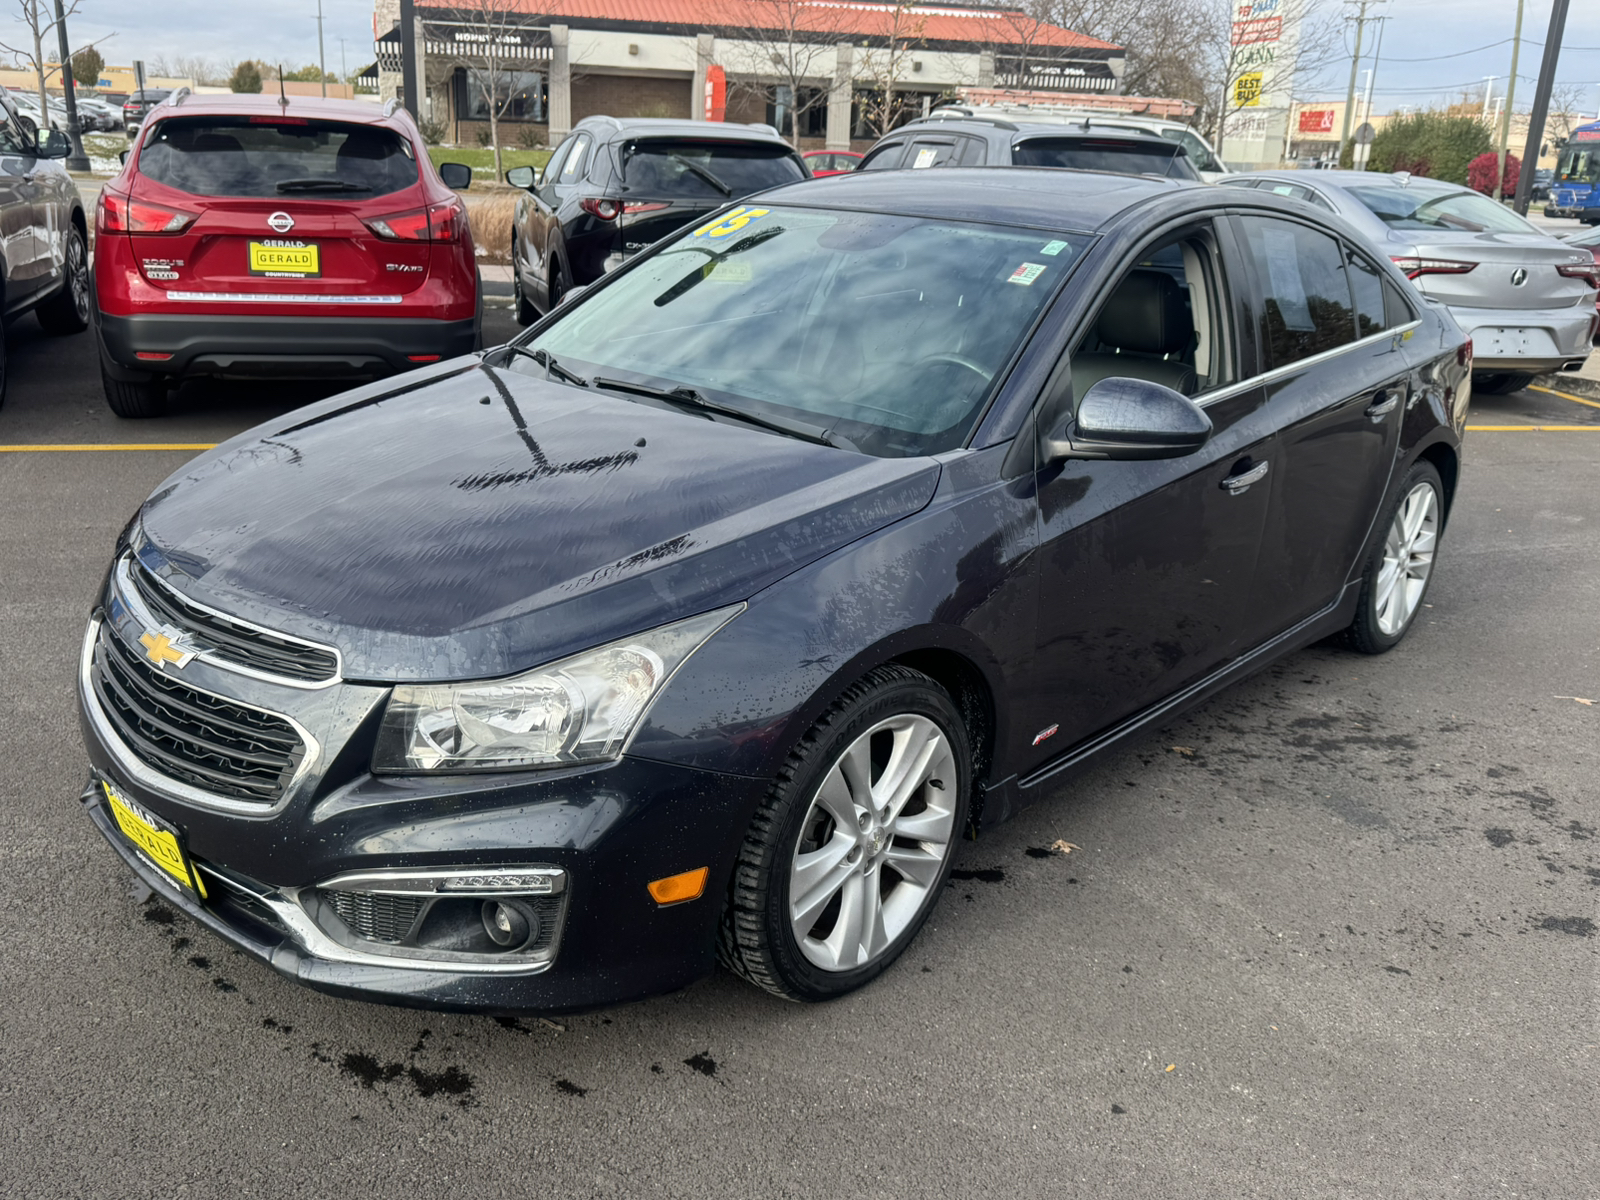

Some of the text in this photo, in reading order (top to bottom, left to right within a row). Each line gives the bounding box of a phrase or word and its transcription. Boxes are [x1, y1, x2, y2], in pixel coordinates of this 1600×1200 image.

[1238, 78, 1261, 89] BEST
[1238, 90, 1256, 101] BUY
[693, 207, 770, 237] 15
[263, 239, 305, 249] GERALD
[259, 254, 309, 263] GERALD
[110, 785, 157, 830] GERALD
[119, 811, 180, 864] GERALD
